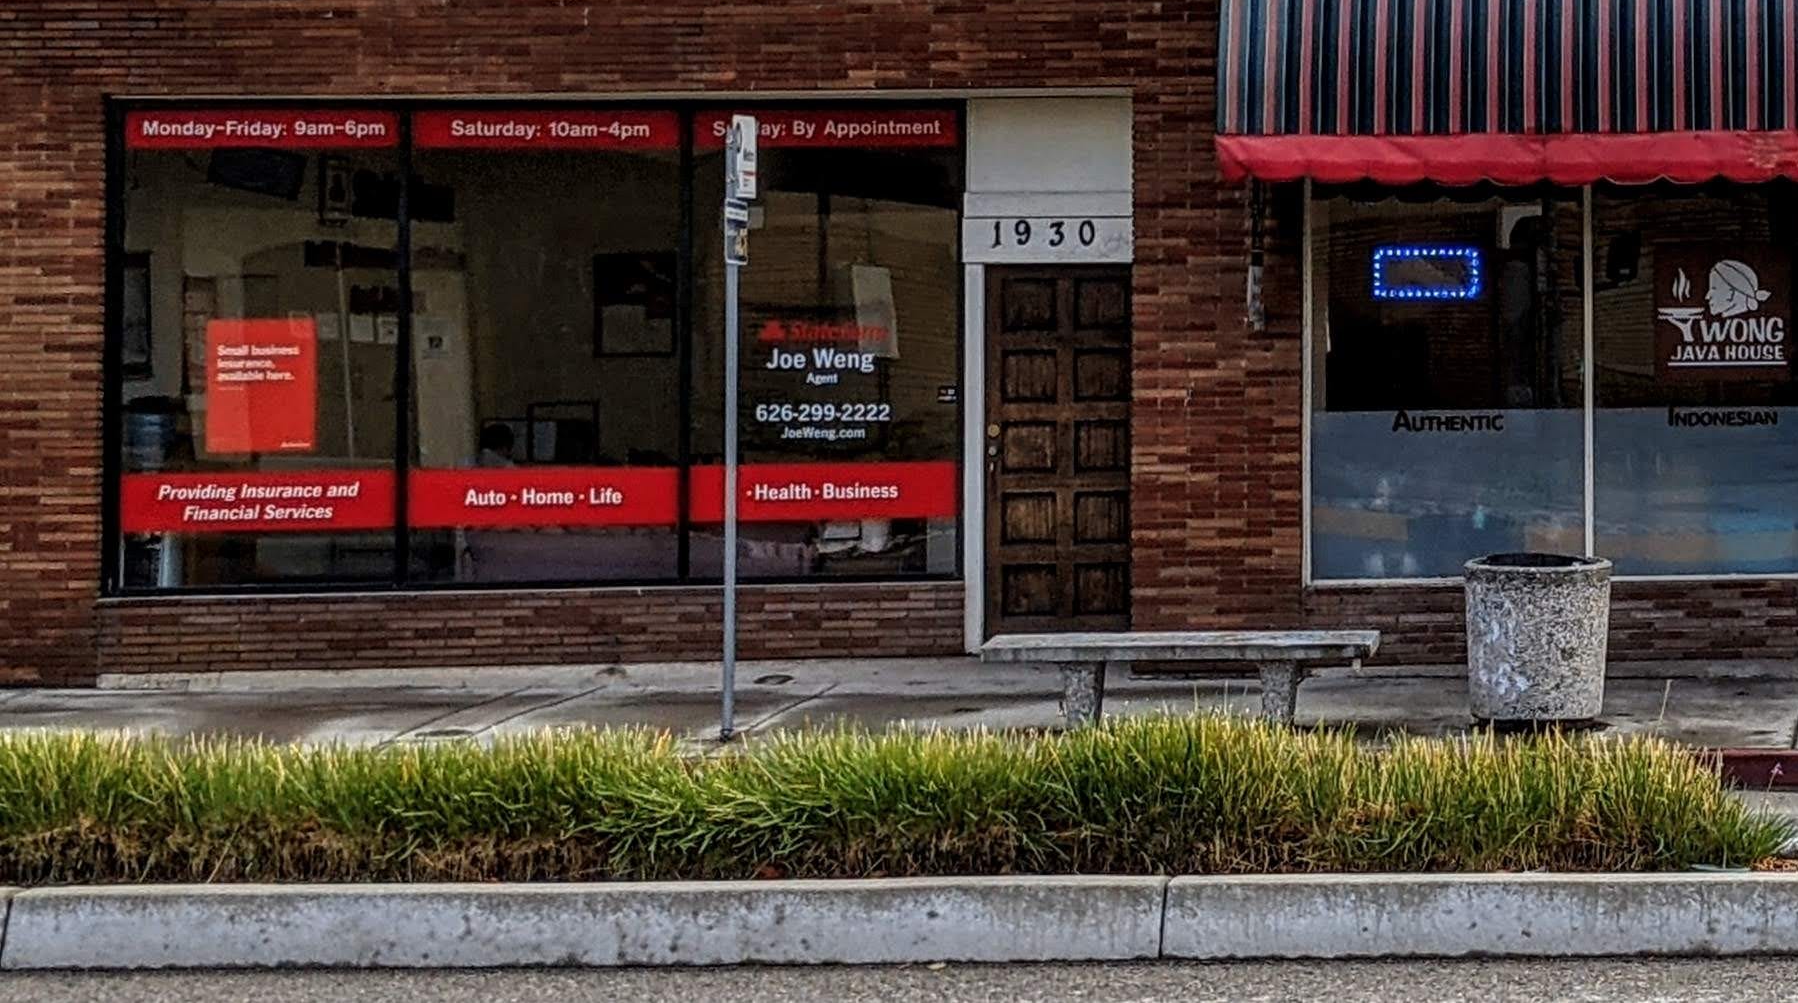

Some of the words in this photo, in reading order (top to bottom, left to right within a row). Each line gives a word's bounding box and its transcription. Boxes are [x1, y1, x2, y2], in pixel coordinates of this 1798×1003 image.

[142, 119, 288, 138] Monday-Friday:
[294, 120, 386, 138] 9am-6pm
[450, 120, 541, 138] Saturday:
[549, 120, 650, 139] 10am-4pm
[792, 119, 816, 138] By
[824, 119, 941, 137] Appointment
[991, 219, 1096, 249] 1930
[1700, 317, 1785, 343] WONG
[766, 348, 806, 369] Joe
[812, 348, 875, 373] Weng
[1671, 345, 1720, 360] JAVA
[1725, 344, 1785, 360] HOUSE
[806, 372, 838, 385] Agent
[755, 403, 891, 423] 626-299-2222
[781, 426, 866, 441] JoeWeng.com
[158, 484, 236, 501] Providing
[240, 484, 322, 498] Insurance
[327, 481, 360, 497] and
[465, 488, 507, 507] Auto
[521, 488, 574, 506] Home
[589, 487, 623, 505] Life
[754, 484, 812, 501] Health
[822, 482, 898, 500] Business
[183, 505, 259, 522] Financial
[264, 505, 333, 521] Services
